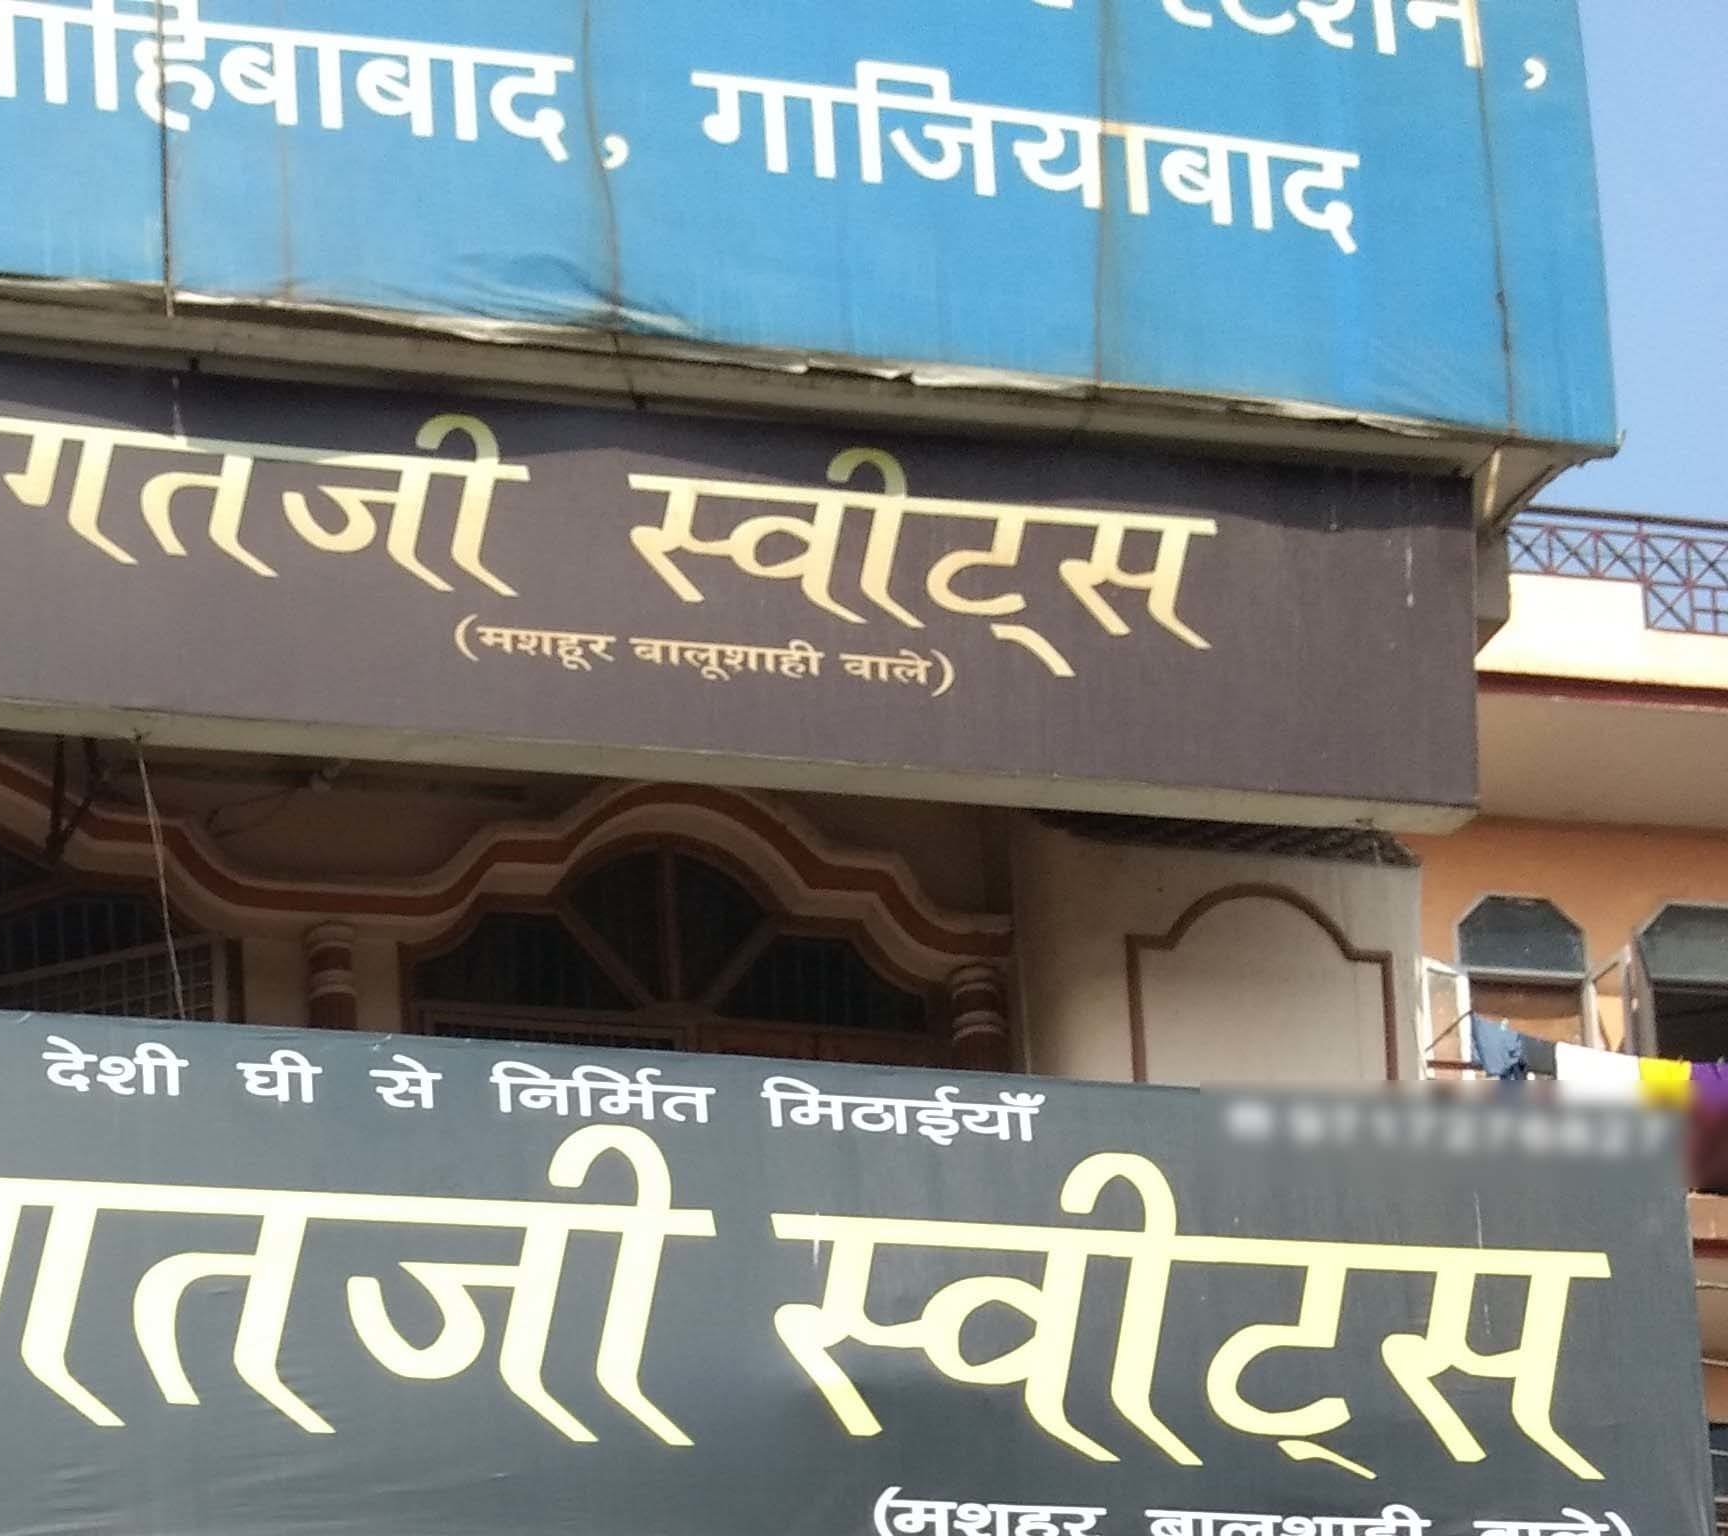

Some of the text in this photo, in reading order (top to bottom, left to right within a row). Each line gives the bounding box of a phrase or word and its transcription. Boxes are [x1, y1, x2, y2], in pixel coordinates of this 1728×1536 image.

[690, 60, 1360, 254] गाजियाबाद
[628, 447, 1217, 676] स्वीट्स
[41, 1035, 190, 1097] देशी
[235, 1049, 323, 1104] घी
[369, 1054, 443, 1110] से
[489, 1060, 716, 1124] निर्मित
[771, 1153, 1611, 1480] स्वीट्स
